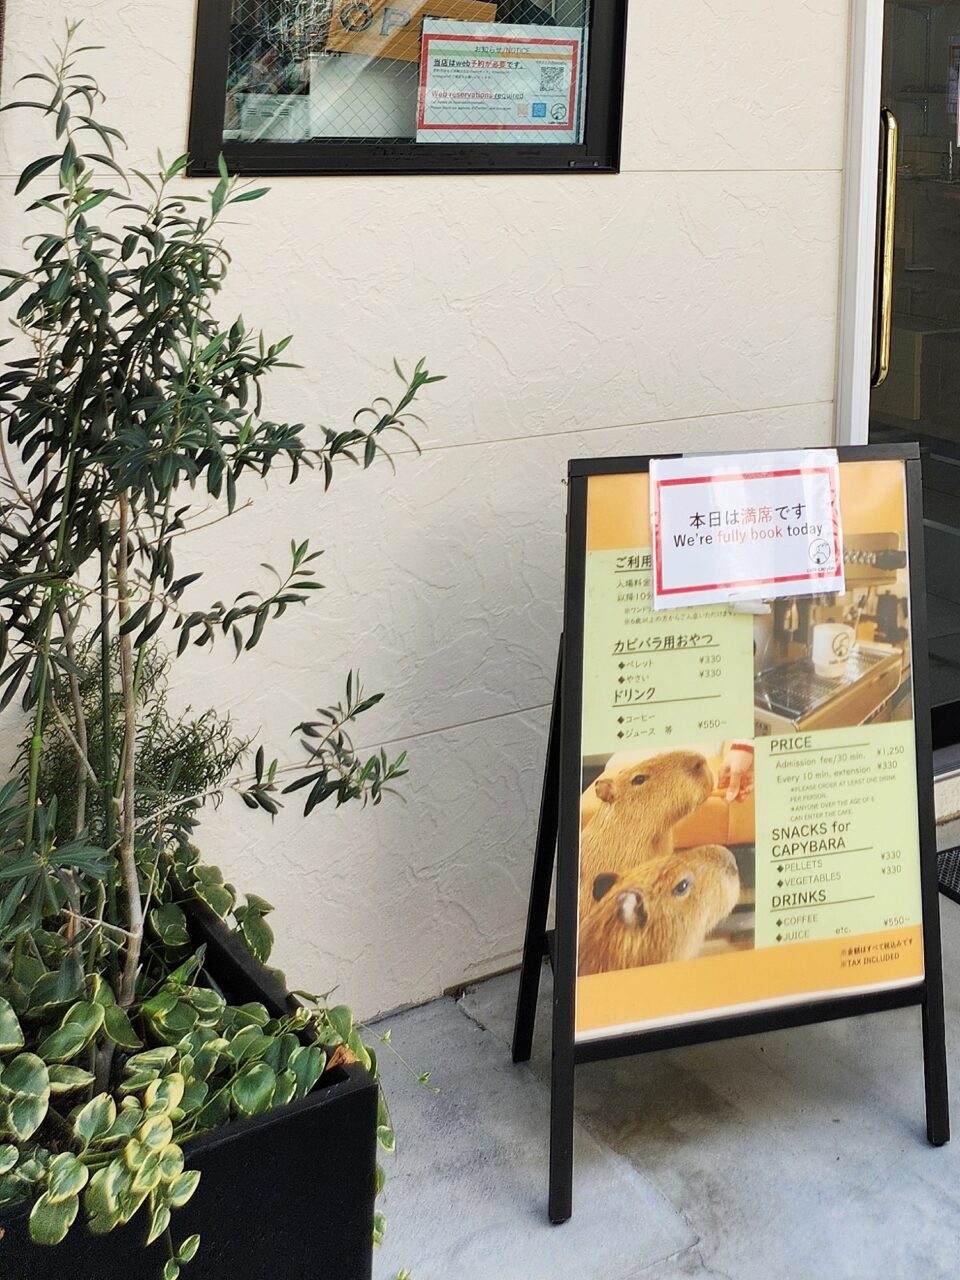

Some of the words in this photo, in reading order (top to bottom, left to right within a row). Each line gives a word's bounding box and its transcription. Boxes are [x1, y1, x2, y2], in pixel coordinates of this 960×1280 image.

[689, 503, 806, 529] 本日は満席です
[673, 533, 713, 548] We're
[717, 529, 746, 545] fully
[751, 525, 783, 540] book
[787, 522, 823, 538] today
[614, 633, 713, 653] カピバラ用おやつ
[699, 654, 722, 664] ¥330
[699, 668, 722, 679] ¥330
[614, 687, 656, 704] ドリンク
[770, 735, 812, 752] PRICE
[775, 756, 816, 769] Admission
[819, 753, 848, 765] fee/30
[776, 774, 801, 785] Every
[803, 771, 813, 781] 10
[833, 766, 871, 777] extension
[877, 760, 898, 770] ¥330
[771, 822, 828, 841] SNACKS
[832, 820, 851, 833] for
[771, 836, 846, 858] CAPYBARA
[881, 849, 902, 860] ¥330
[881, 864, 902, 875] ¥330
[771, 889, 827, 908] DRINKS
[863, 952, 900, 966] INCLUDED
